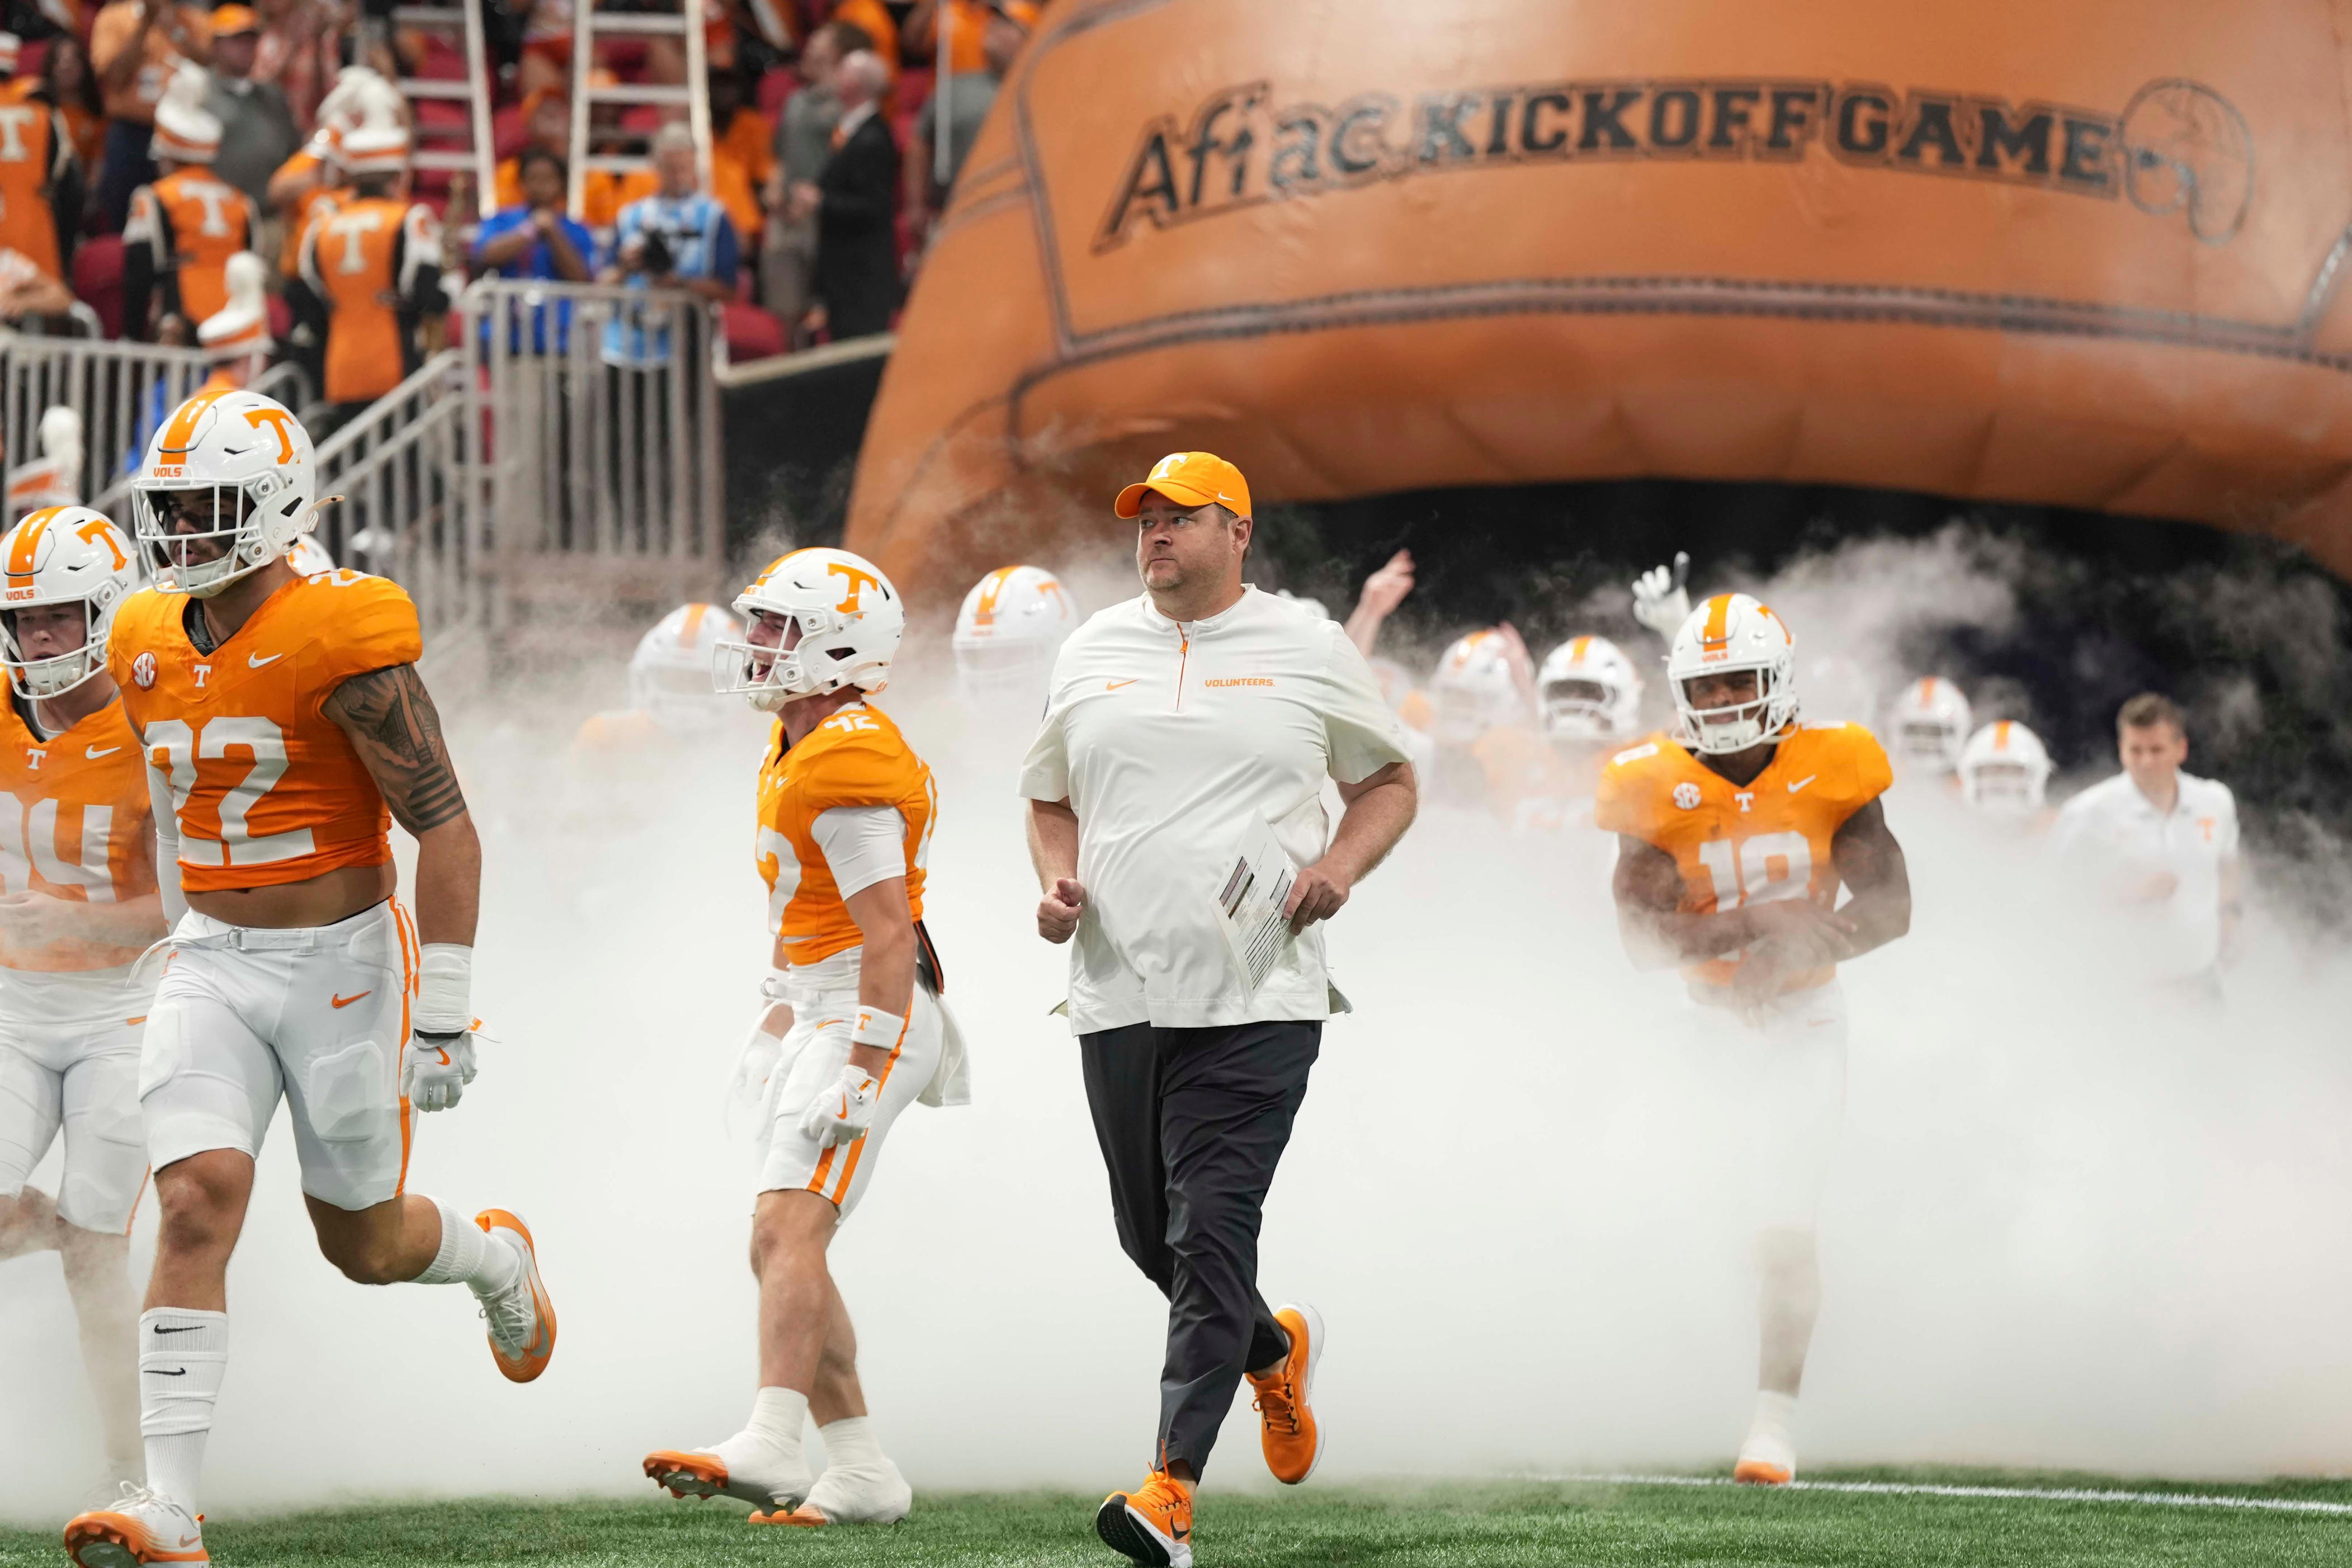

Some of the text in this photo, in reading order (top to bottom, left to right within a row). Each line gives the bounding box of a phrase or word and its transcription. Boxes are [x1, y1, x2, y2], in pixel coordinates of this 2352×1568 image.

[1416, 87, 1817, 163] KICKOFF
[1835, 92, 2113, 187] GAME
[179, 182, 233, 236] T
[329, 212, 383, 274] T
[243, 409, 300, 465] T
[154, 467, 182, 477] VOLS
[1152, 454, 1188, 479] T
[76, 518, 127, 572] T
[6, 589, 34, 601] VOLS
[828, 563, 879, 620] T
[133, 653, 155, 687] SEC
[194, 665, 211, 687] T
[1205, 678, 1274, 687] VOLUNTEERS
[823, 714, 880, 733] 42
[27, 748, 46, 770] T
[144, 716, 316, 866] 22
[1673, 783, 1702, 810] SEC
[1735, 792, 1754, 812] T
[859, 1013, 872, 1031] T
